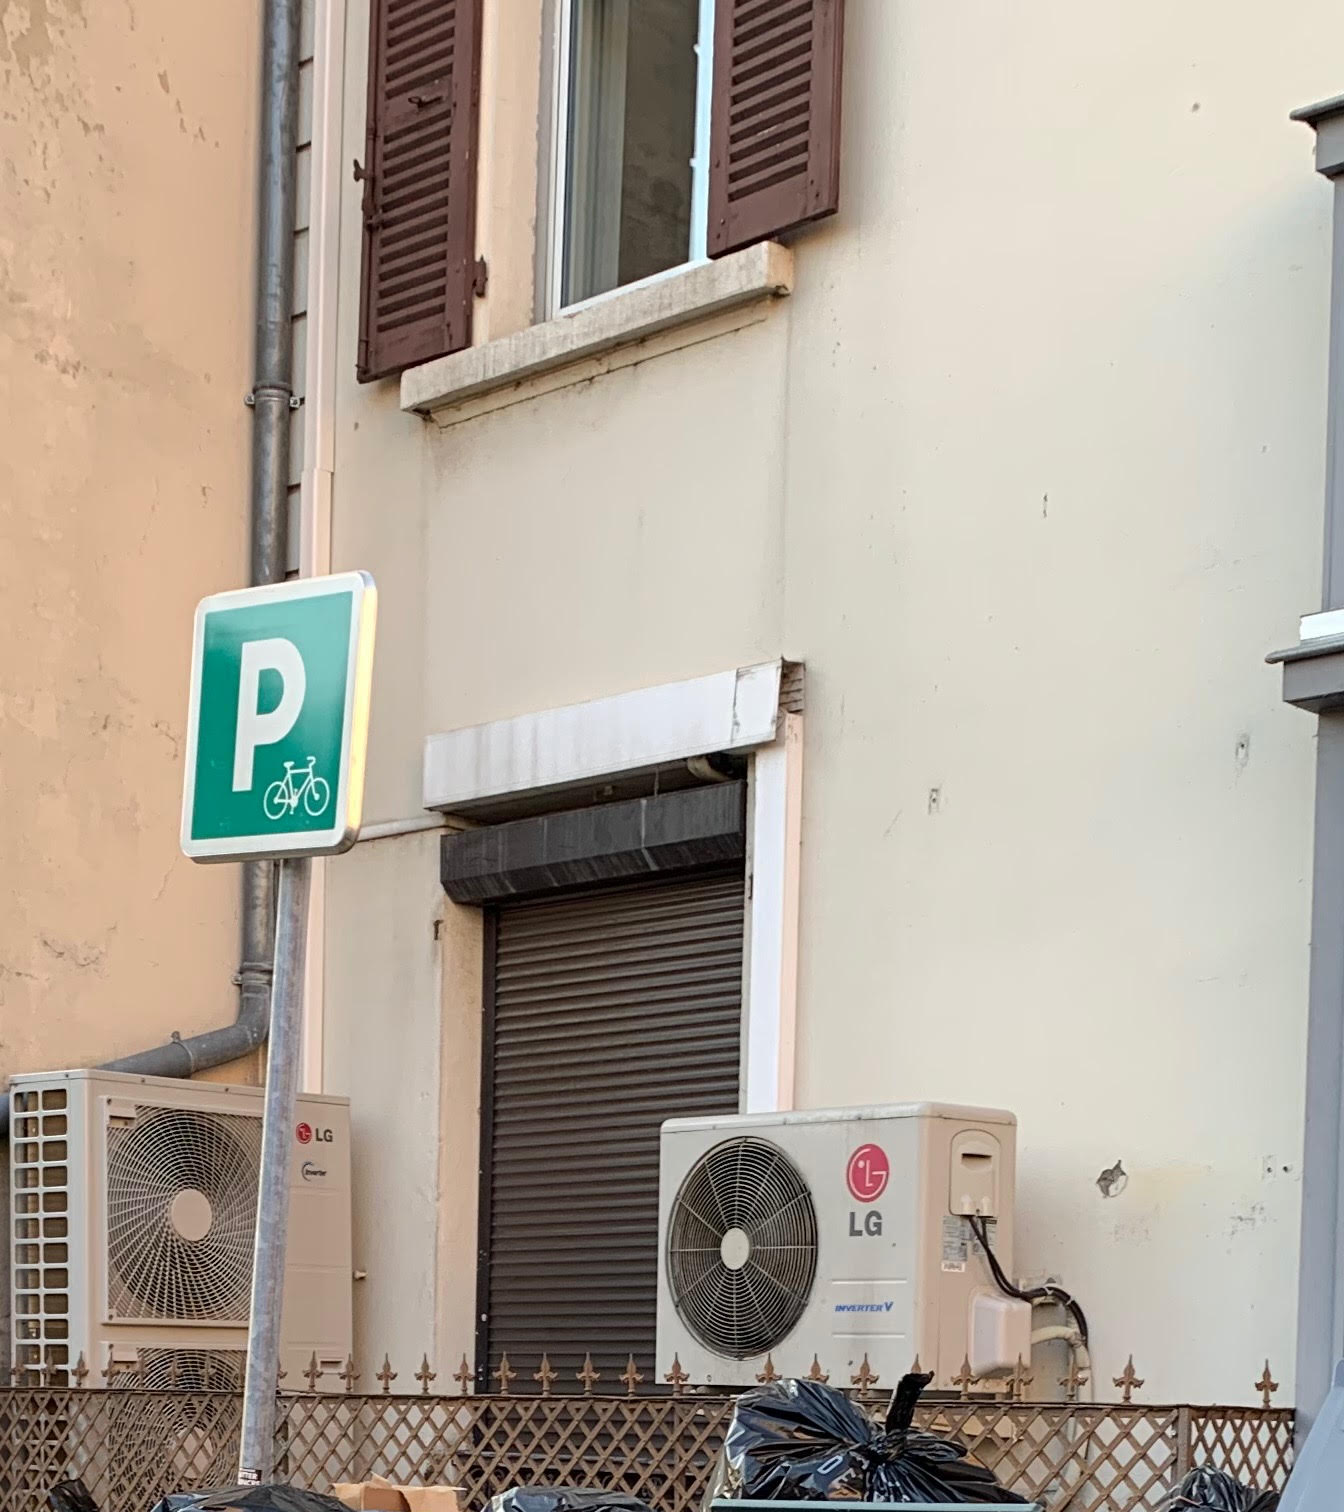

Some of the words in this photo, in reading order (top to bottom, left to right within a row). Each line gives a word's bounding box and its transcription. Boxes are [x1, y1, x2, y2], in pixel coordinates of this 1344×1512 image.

[231, 636, 307, 793] P
[314, 1128, 334, 1143] LG
[848, 1209, 883, 1238] LG
[834, 1304, 883, 1312] INVERTER
